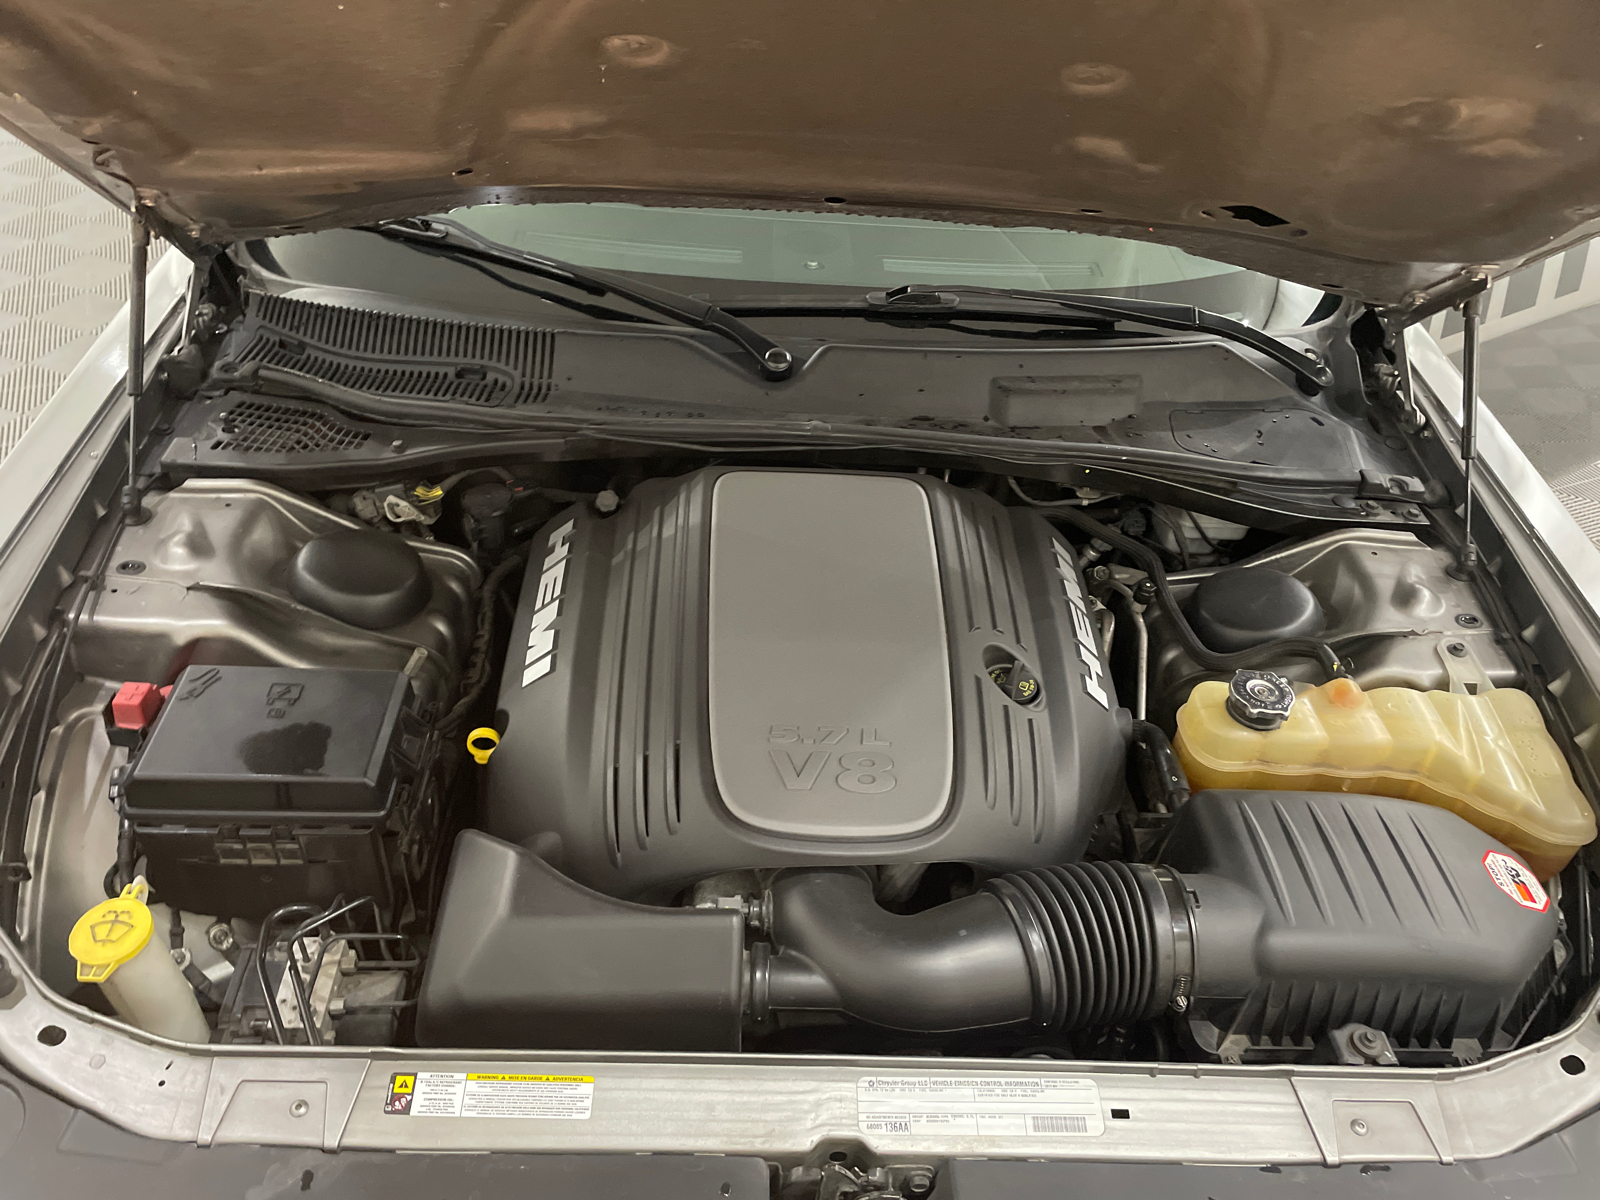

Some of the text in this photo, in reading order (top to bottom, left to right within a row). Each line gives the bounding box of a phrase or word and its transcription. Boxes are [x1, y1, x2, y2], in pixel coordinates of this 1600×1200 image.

[522, 518, 574, 687] HEMI
[1052, 537, 1109, 709] HEMI
[768, 724, 892, 747] 5.7L
[769, 750, 897, 794] V8
[877, 1080, 901, 1088] Chrysler
[901, 1080, 917, 1088] Group
[866, 1122, 910, 1133] 68085 136AA
